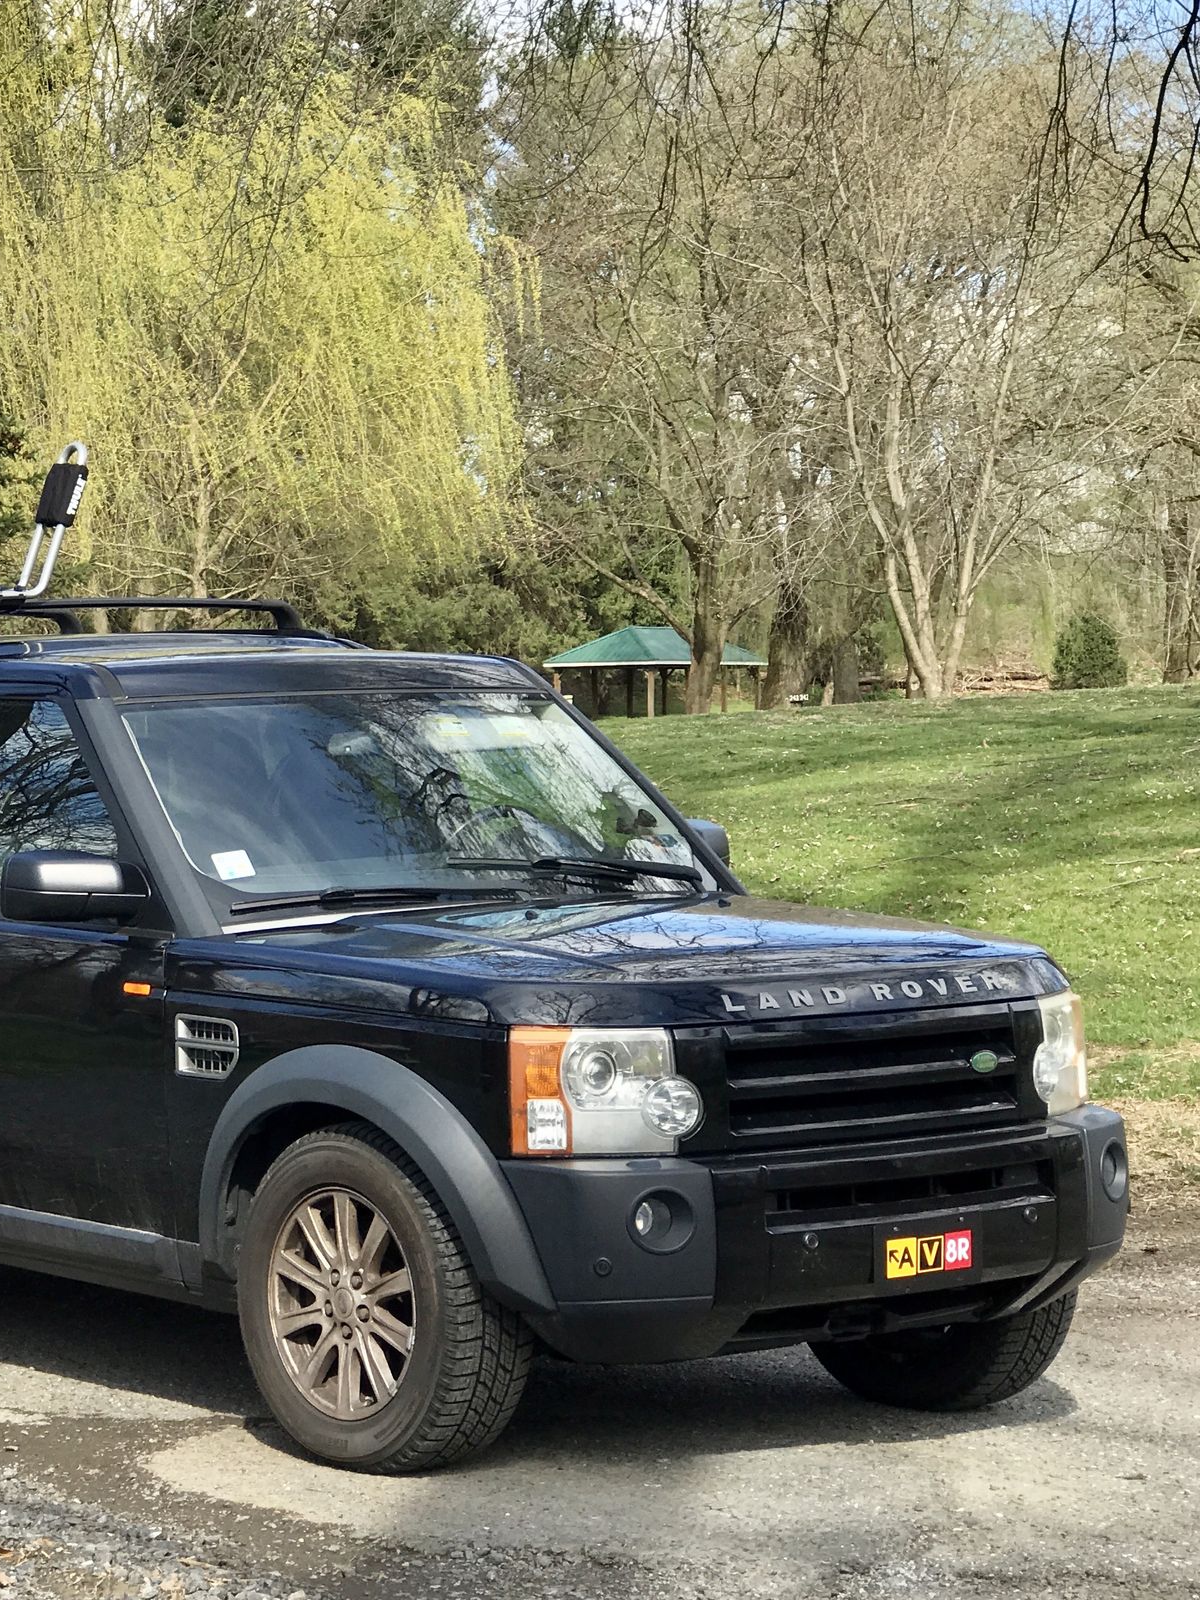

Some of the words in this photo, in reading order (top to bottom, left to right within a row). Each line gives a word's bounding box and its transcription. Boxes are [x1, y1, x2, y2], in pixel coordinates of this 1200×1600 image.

[66, 477, 88, 516] THULE
[720, 985, 850, 1013] LAND
[868, 971, 1003, 1001] ROVER
